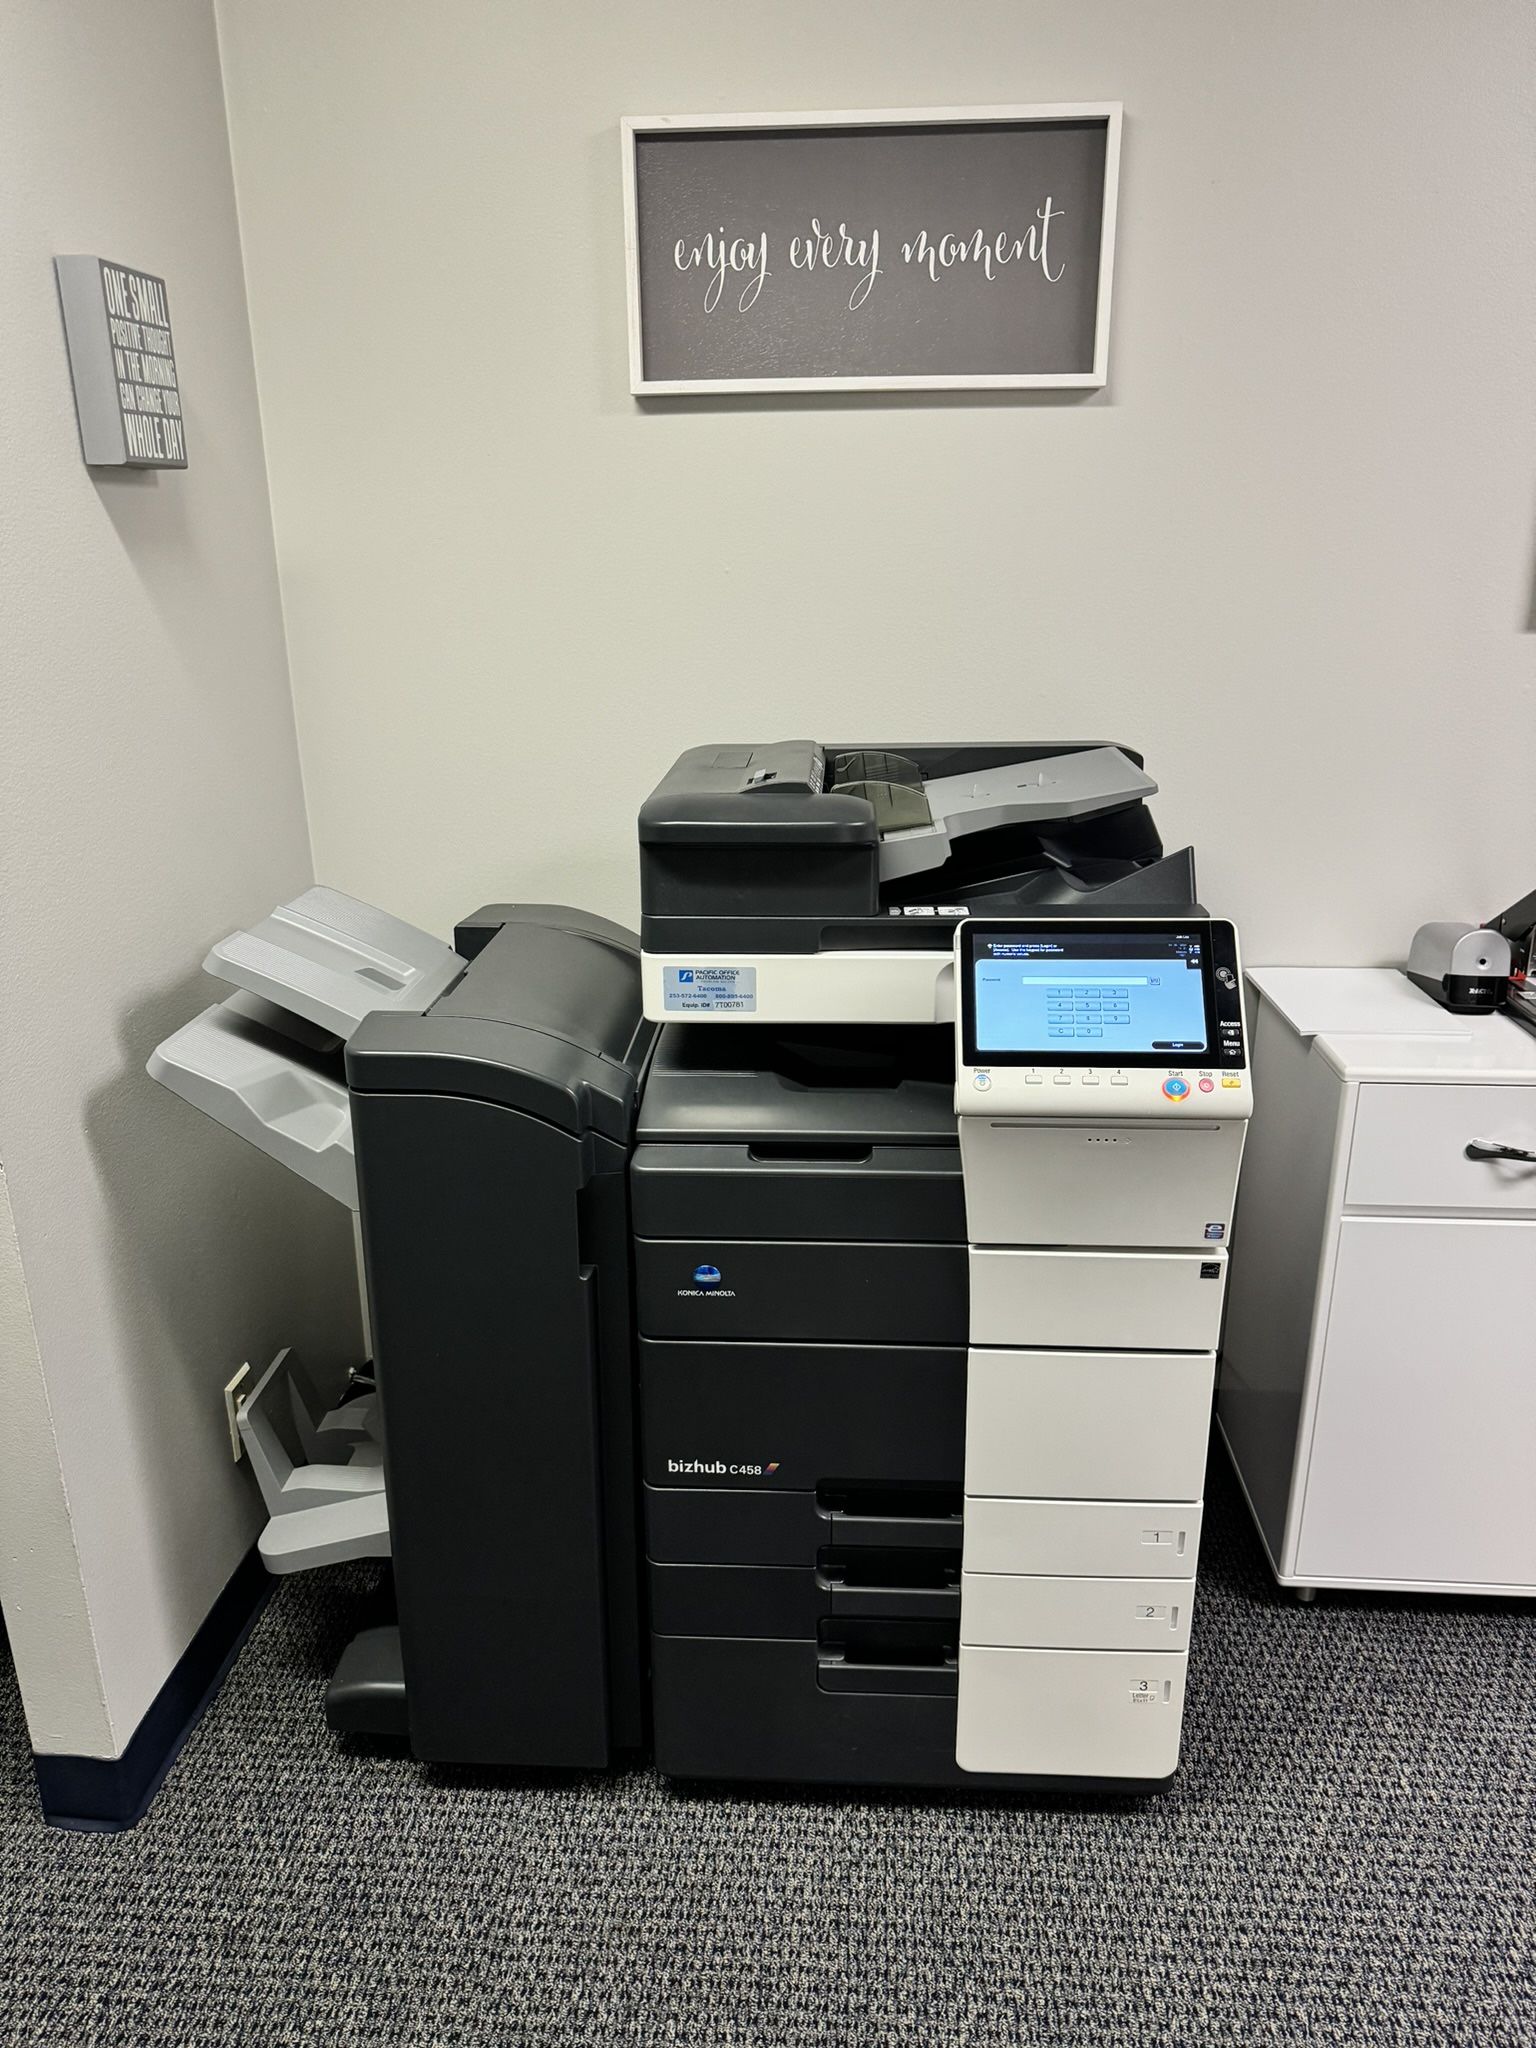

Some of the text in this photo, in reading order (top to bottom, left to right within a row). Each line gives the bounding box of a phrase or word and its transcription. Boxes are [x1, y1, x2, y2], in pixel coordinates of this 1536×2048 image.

[673, 196, 1066, 313] enjoy every moment
[103, 266, 170, 328] ONE SMALL
[109, 317, 143, 351] POSITIVE
[113, 347, 177, 388] IN THE MORNING
[119, 382, 181, 417] CAN CHANGE YOUR
[123, 413, 185, 460] WHOLE DAY
[668, 1459, 762, 1475] bizhub C458
[1153, 1532, 1160, 1543] 1
[1146, 1607, 1155, 1617] 2
[1139, 1680, 1148, 1691] 3
